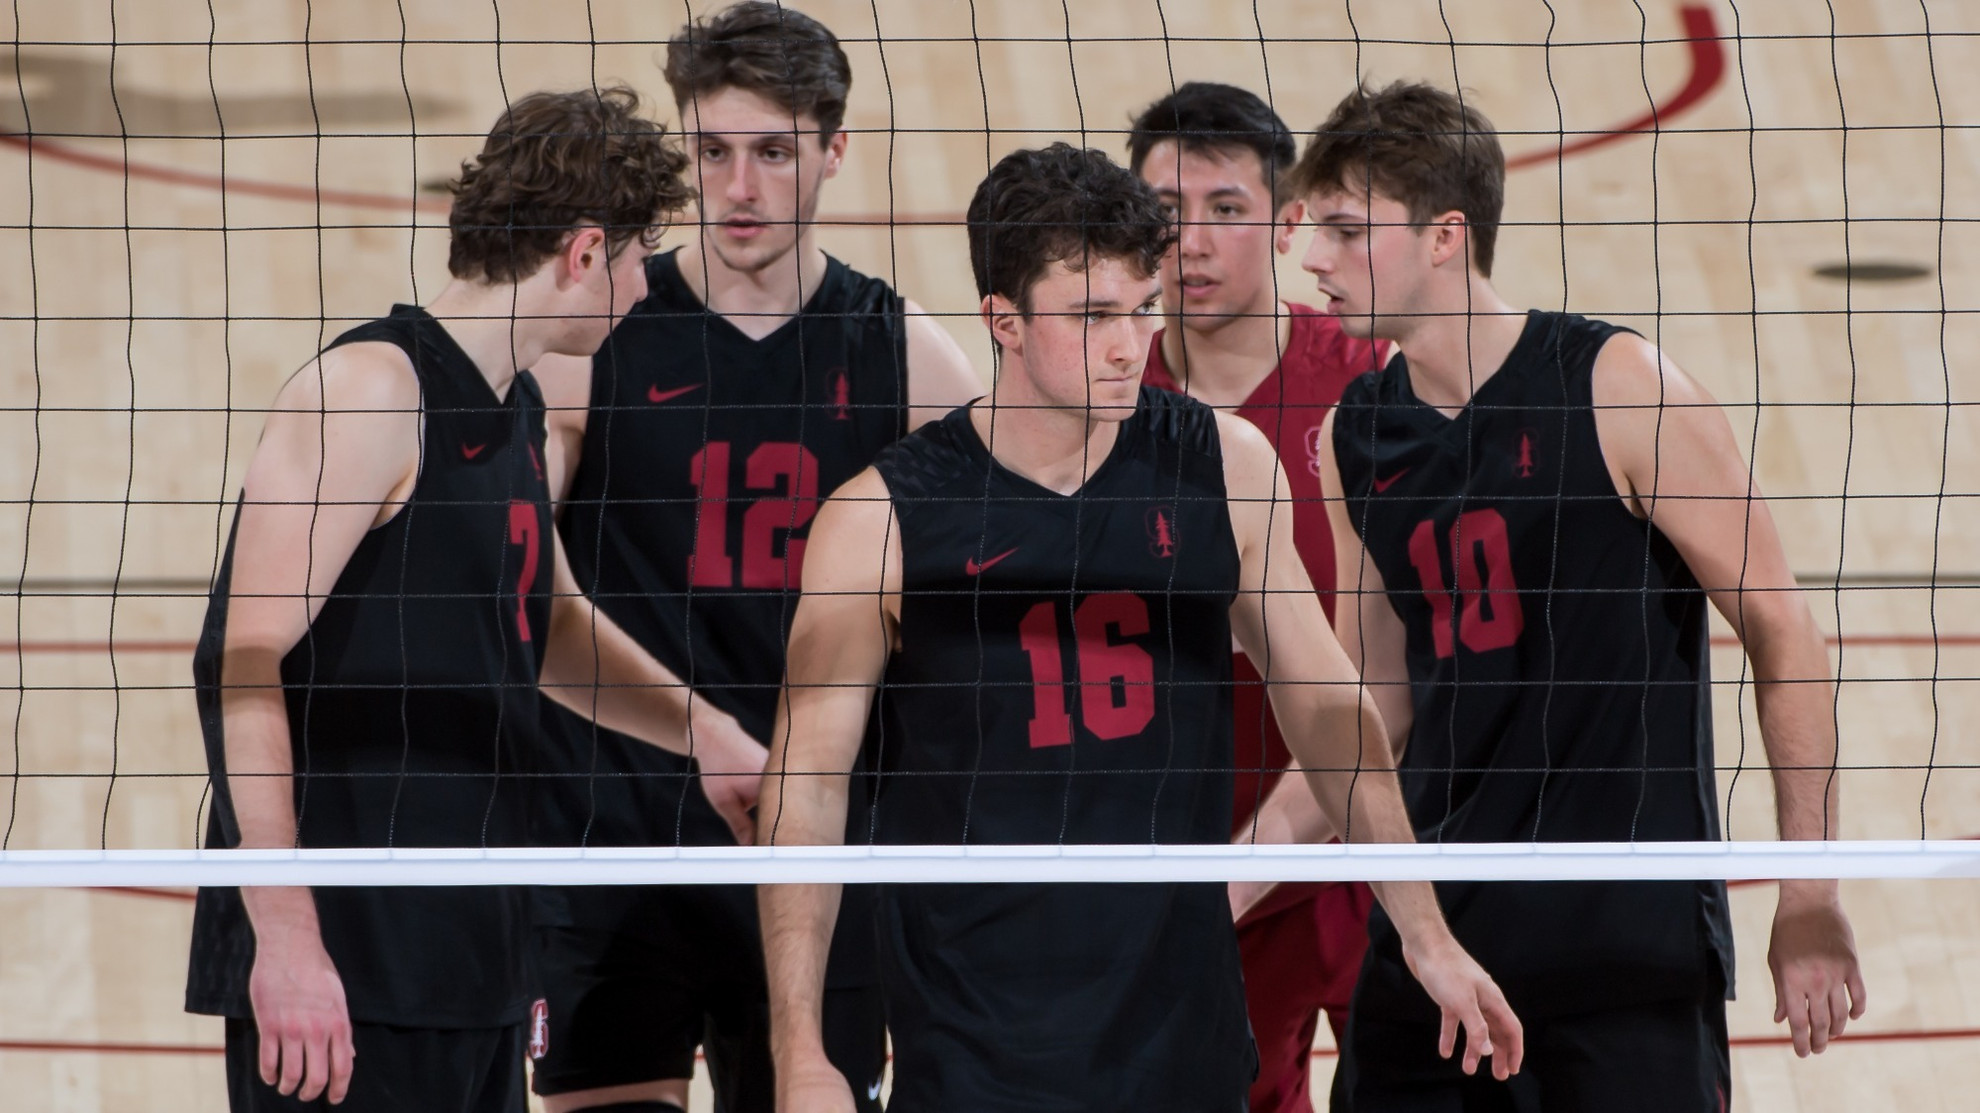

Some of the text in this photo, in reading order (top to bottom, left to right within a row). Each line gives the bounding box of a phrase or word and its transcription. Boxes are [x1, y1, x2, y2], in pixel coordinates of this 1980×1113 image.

[509, 499, 539, 641] 7
[689, 441, 818, 588] 12
[1408, 508, 1524, 659] 10
[1019, 589, 1155, 748] 16
